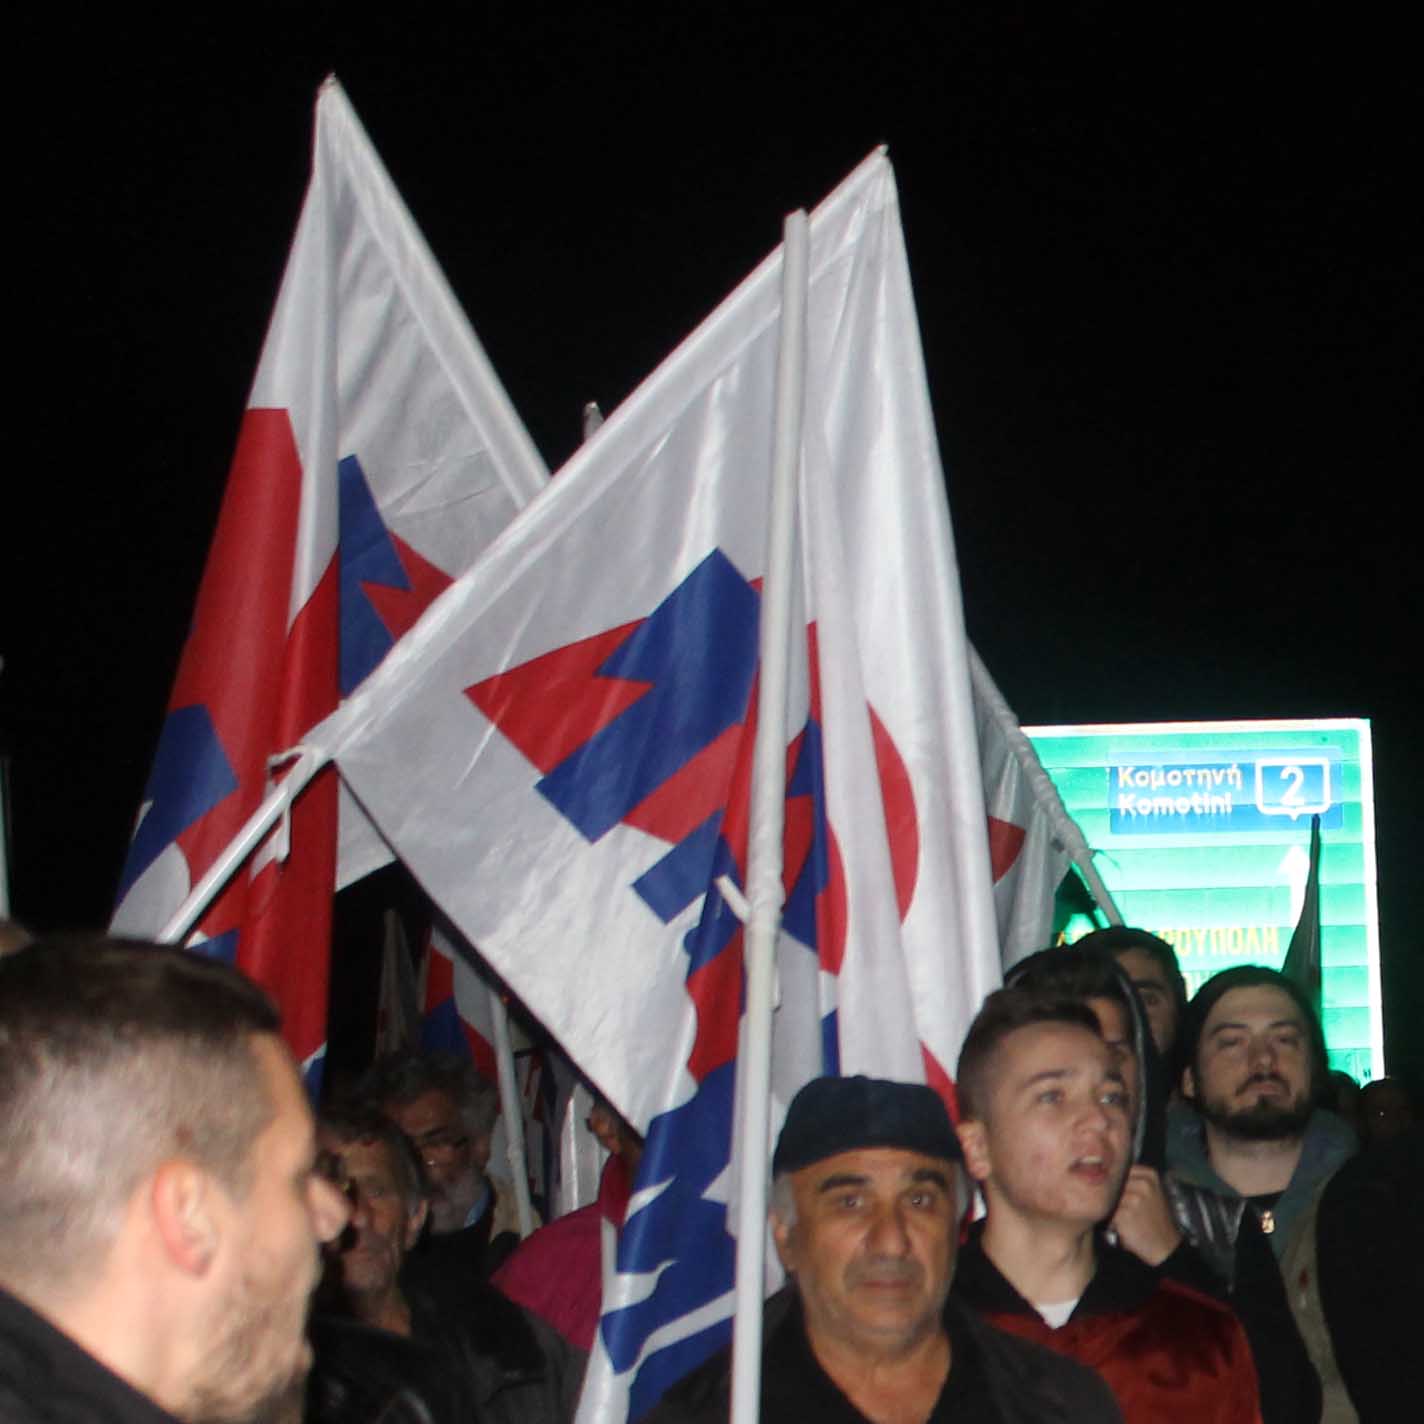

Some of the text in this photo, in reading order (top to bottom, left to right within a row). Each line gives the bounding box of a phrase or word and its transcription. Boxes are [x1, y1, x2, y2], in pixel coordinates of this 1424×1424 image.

[1117, 762, 1242, 791] Κομοτηνή
[1280, 765, 1305, 807] 2
[1118, 790, 1233, 817] Komotini
